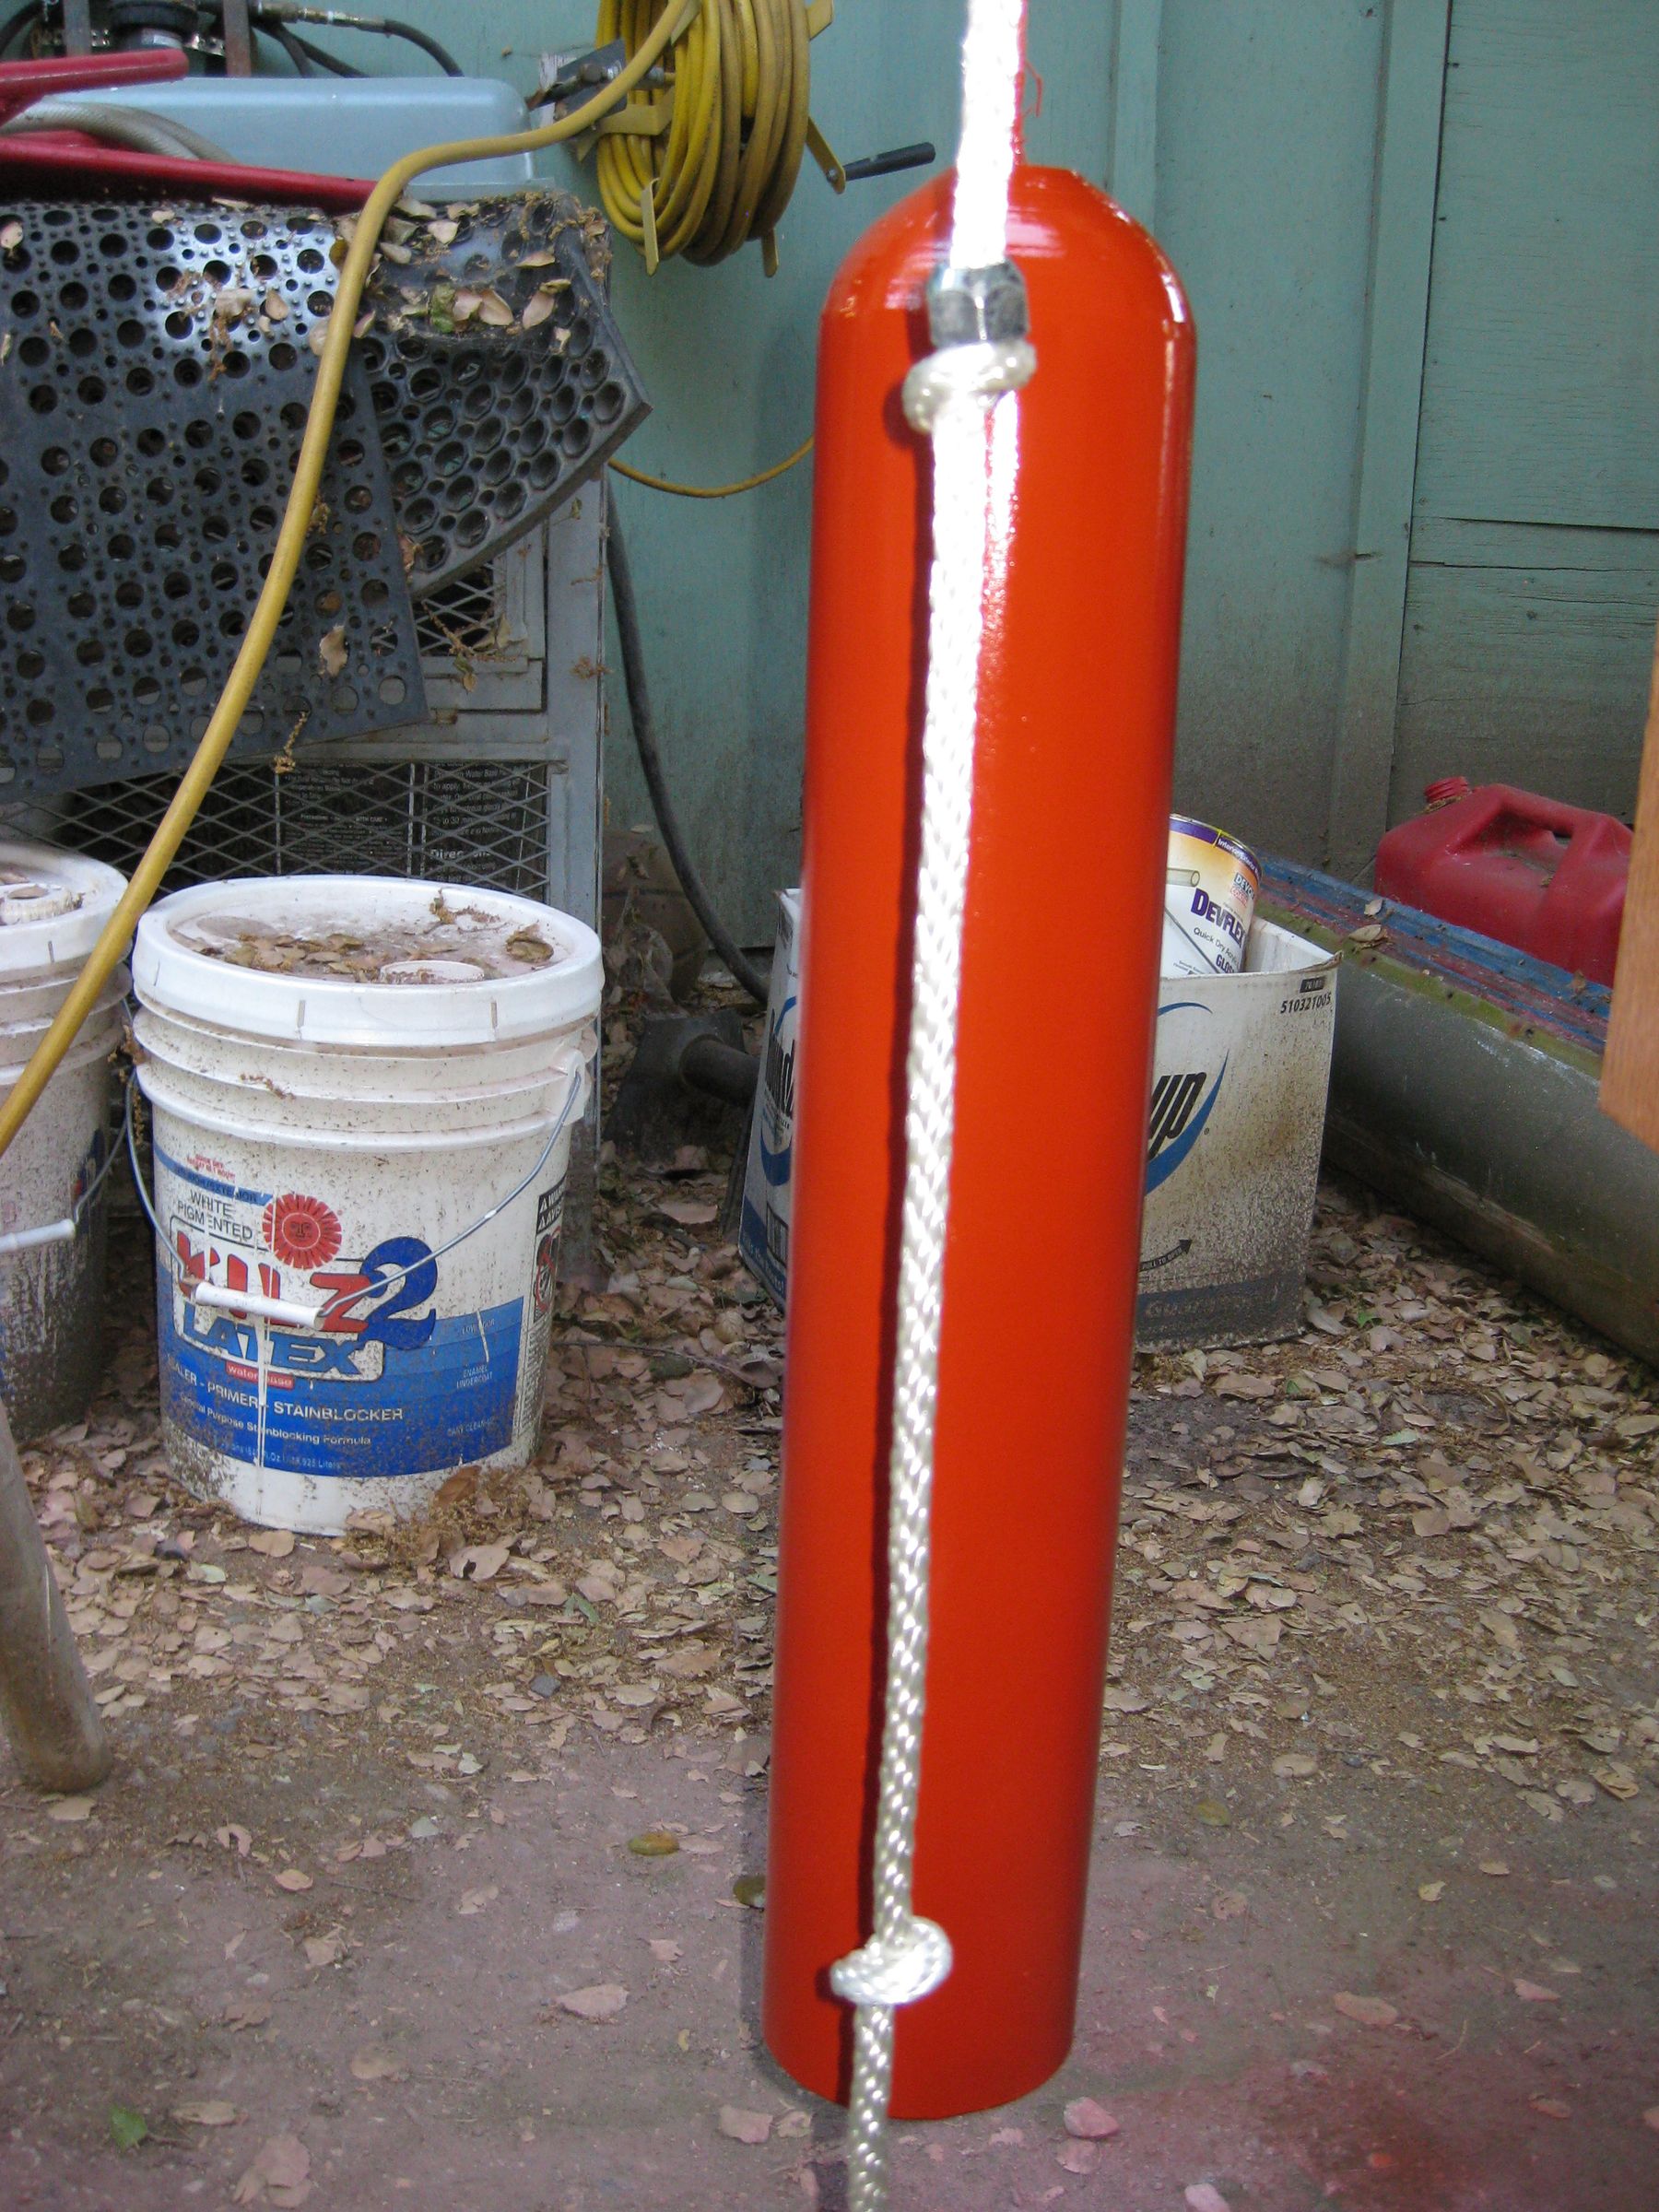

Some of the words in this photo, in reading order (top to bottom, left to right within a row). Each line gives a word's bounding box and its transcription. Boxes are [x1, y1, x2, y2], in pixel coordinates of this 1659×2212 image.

[430, 848, 491, 859] Direcons
[1194, 927, 1214, 943] Quick
[1215, 939, 1226, 952] Dry
[1280, 992, 1332, 1014] 510321005
[177, 1200, 253, 1241] PIGMENTED
[191, 1189, 235, 1218] WHITE
[176, 1230, 371, 1333] KILZ
[358, 1236, 438, 1351] 2
[183, 1298, 370, 1375] LATEX
[228, 1363, 292, 1387] waterase
[207, 1382, 259, 1409] PRIMER
[274, 1400, 404, 1422] STAINBLOCKER
[206, 1407, 244, 1429] Purpose
[246, 1421, 320, 1444] Stnblocking
[323, 1433, 371, 1446] Formula
